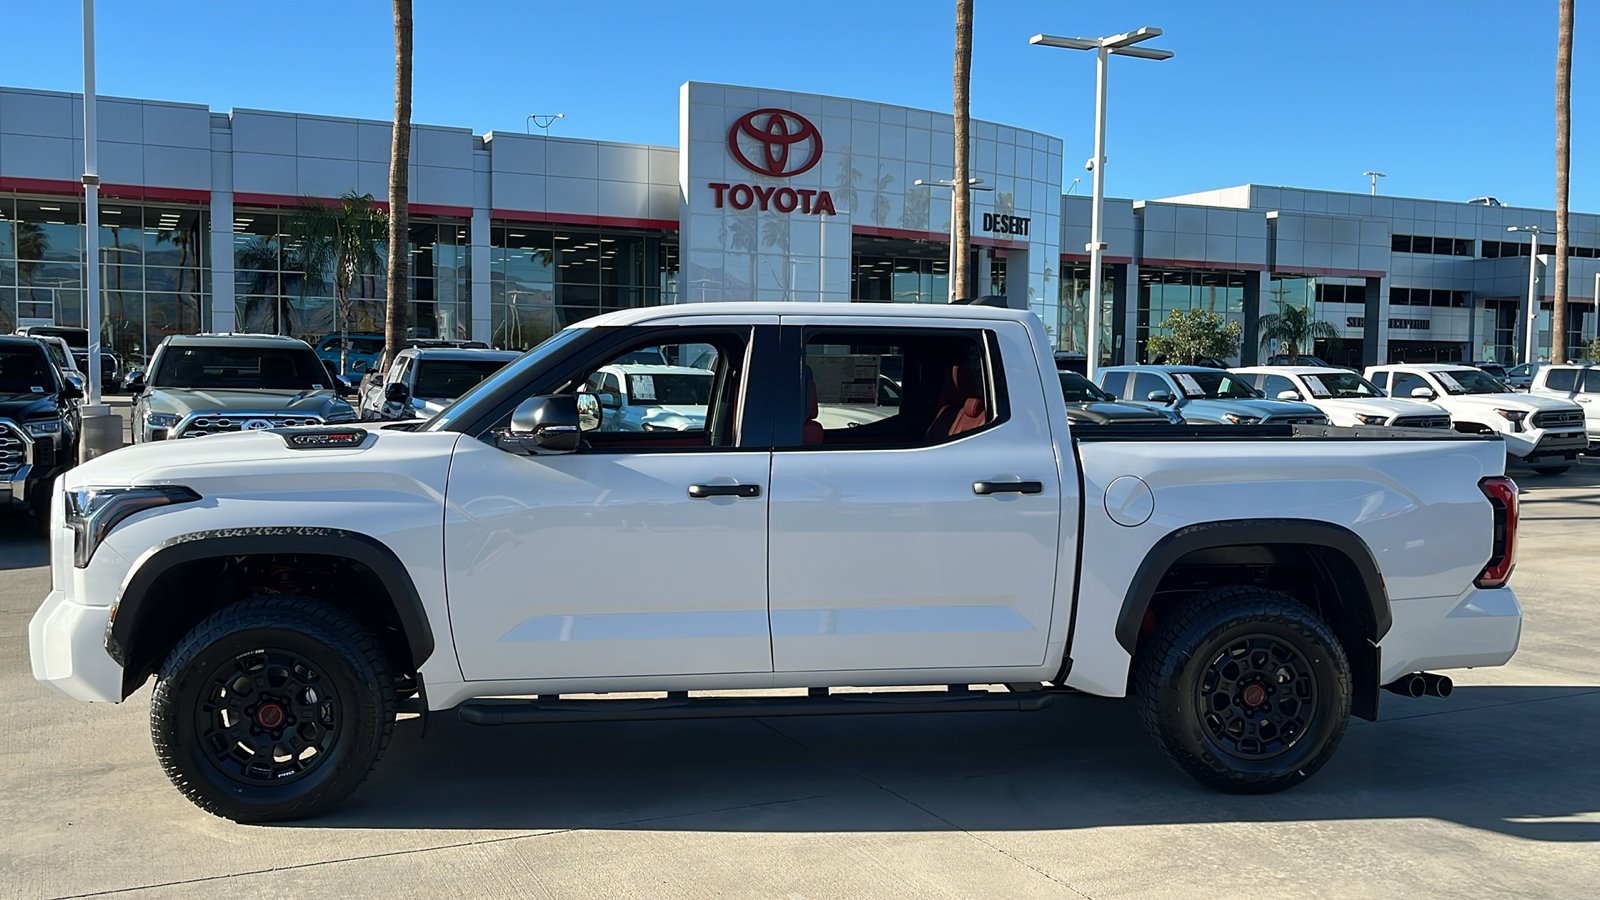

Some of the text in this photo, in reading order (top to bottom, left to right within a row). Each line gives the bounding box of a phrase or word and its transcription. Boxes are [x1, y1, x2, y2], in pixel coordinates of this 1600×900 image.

[708, 182, 837, 216] TOYOTA
[982, 212, 1031, 237] DESERT
[1388, 319, 1430, 329] ECEPTION
[293, 434, 329, 444] TRD
